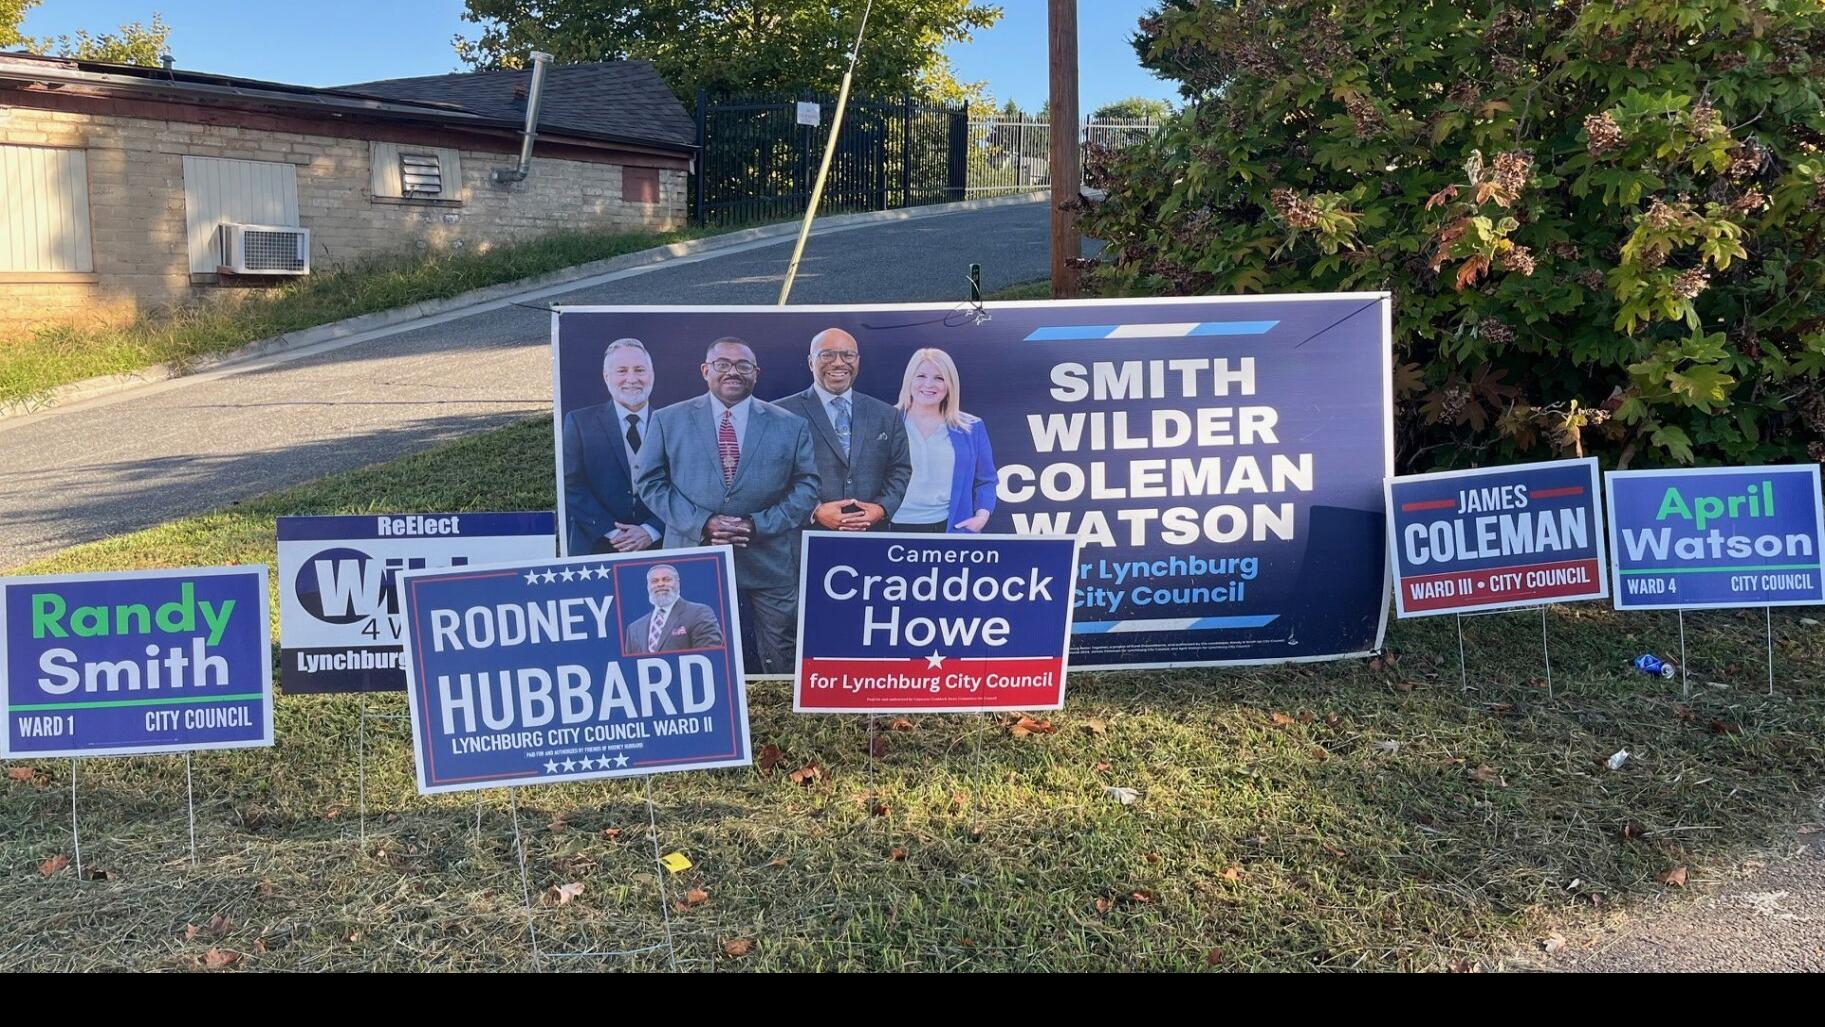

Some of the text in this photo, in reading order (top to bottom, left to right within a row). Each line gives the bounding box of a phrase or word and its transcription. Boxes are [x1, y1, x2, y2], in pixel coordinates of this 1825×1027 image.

[1049, 357, 1256, 402] SMITH
[1027, 405, 1280, 453] WILDER
[995, 453, 1314, 503] COLEMAN
[1457, 484, 1528, 514] JAMES
[1656, 480, 1776, 531] April
[377, 515, 460, 536] ReElect
[1011, 503, 1295, 548] WATSON
[1403, 507, 1588, 566] COLEMAN
[1621, 526, 1813, 562] Watson
[887, 544, 1000, 564] Cameron
[1099, 555, 1259, 585] Lynchburg
[823, 564, 1054, 602] Craddock
[1131, 581, 1245, 606] Council
[1410, 581, 1455, 600] WARD
[1458, 578, 1473, 596] III
[1489, 572, 1523, 593] CITY
[1526, 566, 1591, 588] COUNCIL
[1627, 577, 1677, 595] WARD 4
[1730, 573, 1815, 593] CITY COUNCIL
[32, 582, 236, 646] Randy
[430, 595, 614, 653] RODNEY
[862, 606, 1010, 647] Howe
[38, 636, 229, 694] Smith
[809, 672, 1053, 693] for Lynchburg City Council
[438, 654, 717, 735] HUBBARD
[18, 715, 74, 737] WARD 1
[145, 706, 252, 732] CITY COUNCIL
[451, 716, 713, 755] LYNCHBURG CITY COUNCIL WARD II
